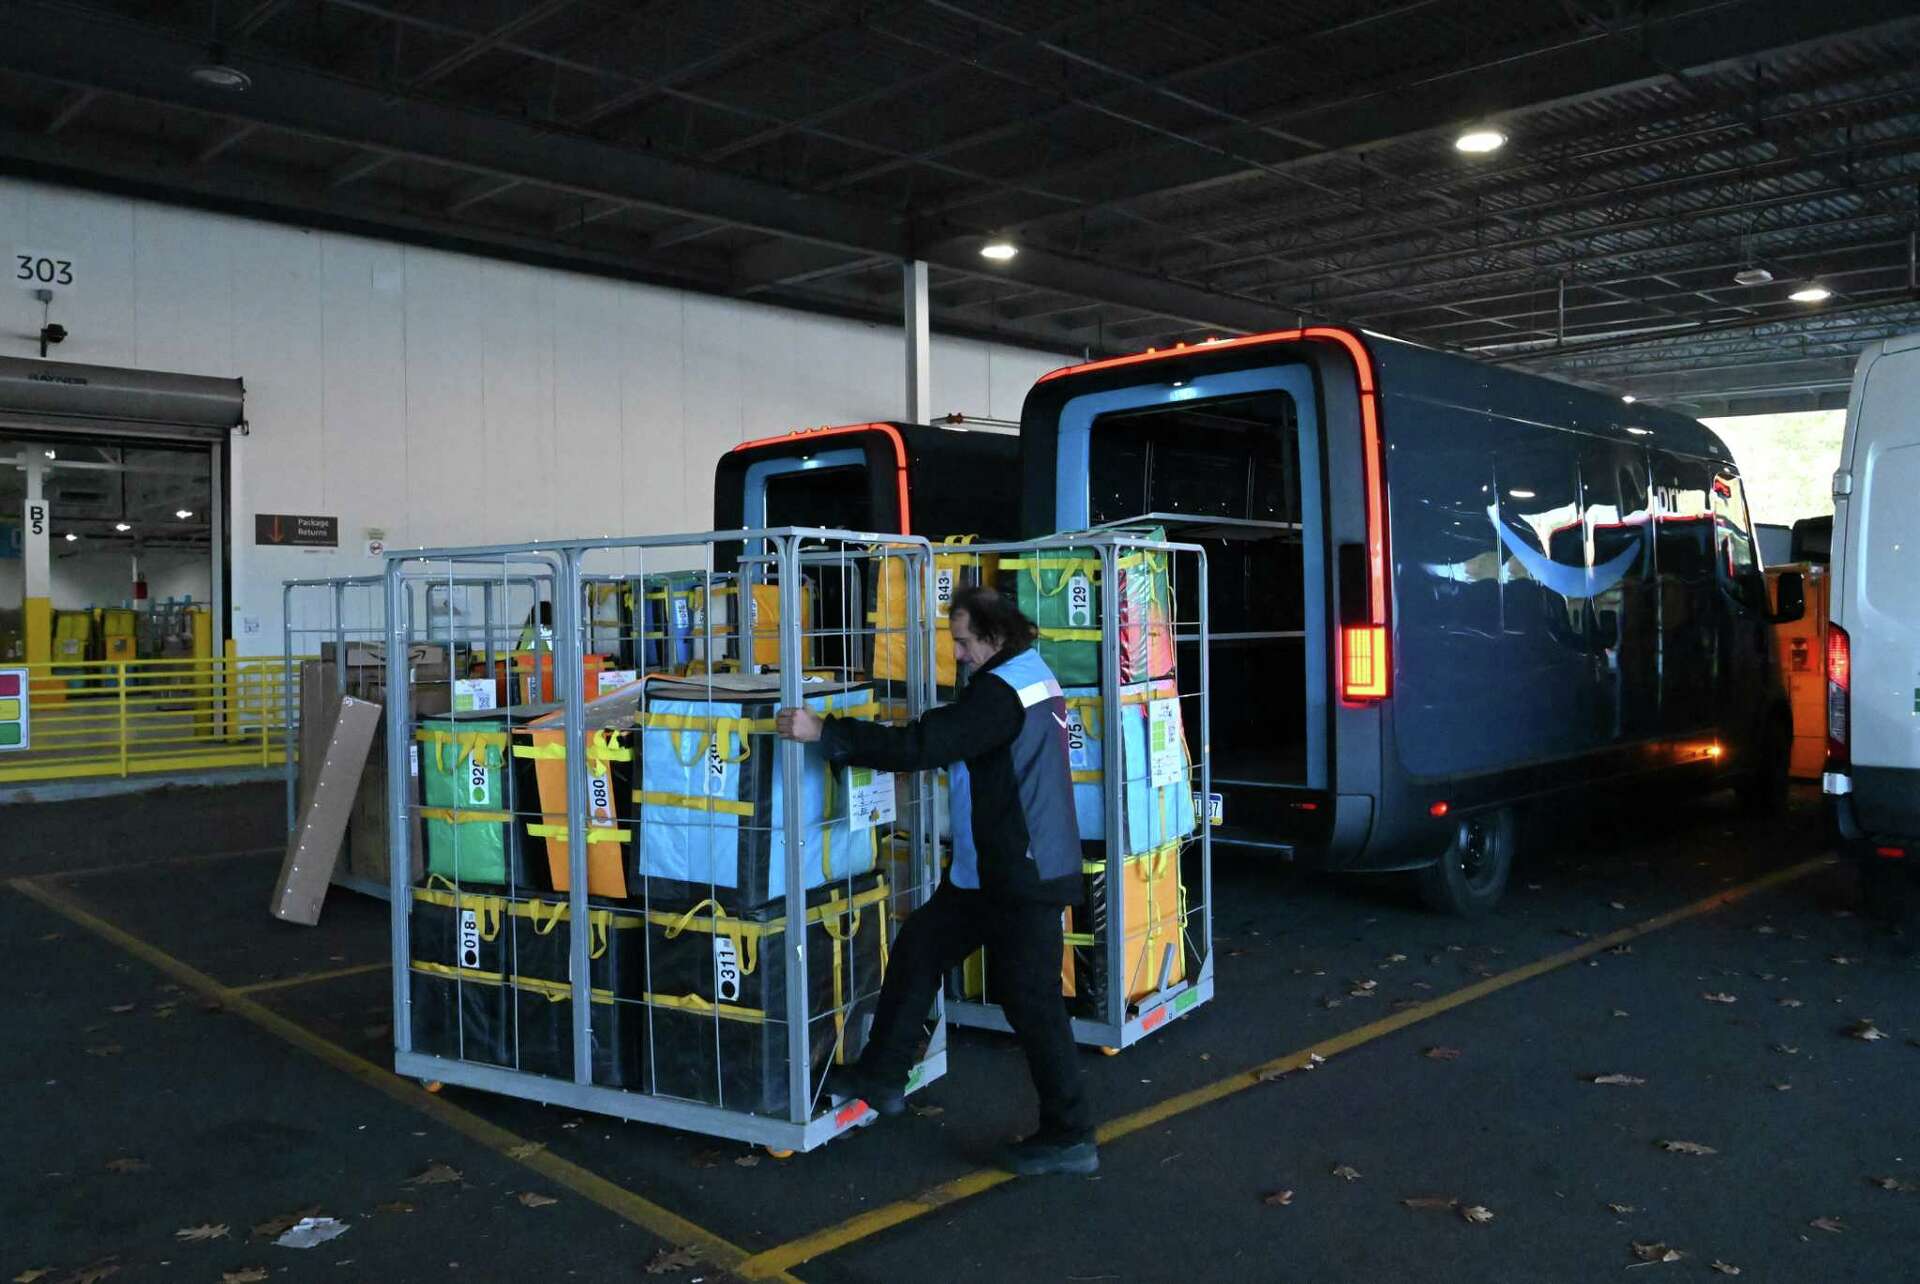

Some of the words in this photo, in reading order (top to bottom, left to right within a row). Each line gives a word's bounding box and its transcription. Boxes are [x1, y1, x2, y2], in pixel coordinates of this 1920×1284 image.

[17, 255, 73, 285] 303
[298, 518, 328, 528] Package
[298, 528, 328, 537] Returns
[938, 577, 950, 600] 843
[1072, 586, 1087, 610] 129
[1069, 724, 1083, 749] 075
[592, 779, 607, 807] 080
[464, 921, 477, 948] 018
[720, 951, 735, 980] 311
